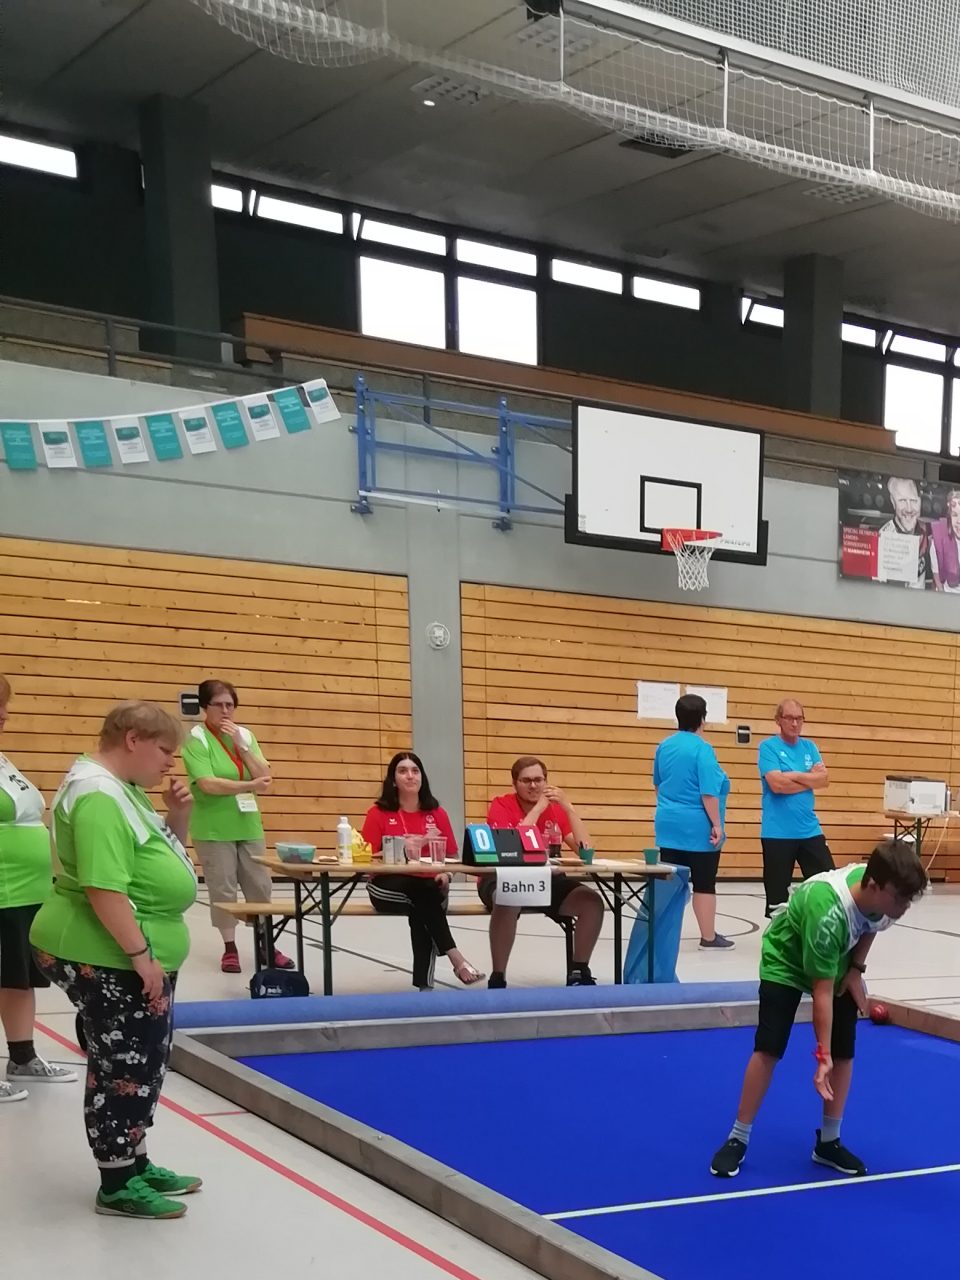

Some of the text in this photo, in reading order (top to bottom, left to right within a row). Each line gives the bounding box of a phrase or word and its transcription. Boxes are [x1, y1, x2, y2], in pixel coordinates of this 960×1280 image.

[475, 829, 539, 849] 0 1
[502, 880, 546, 893] Bahn 3
